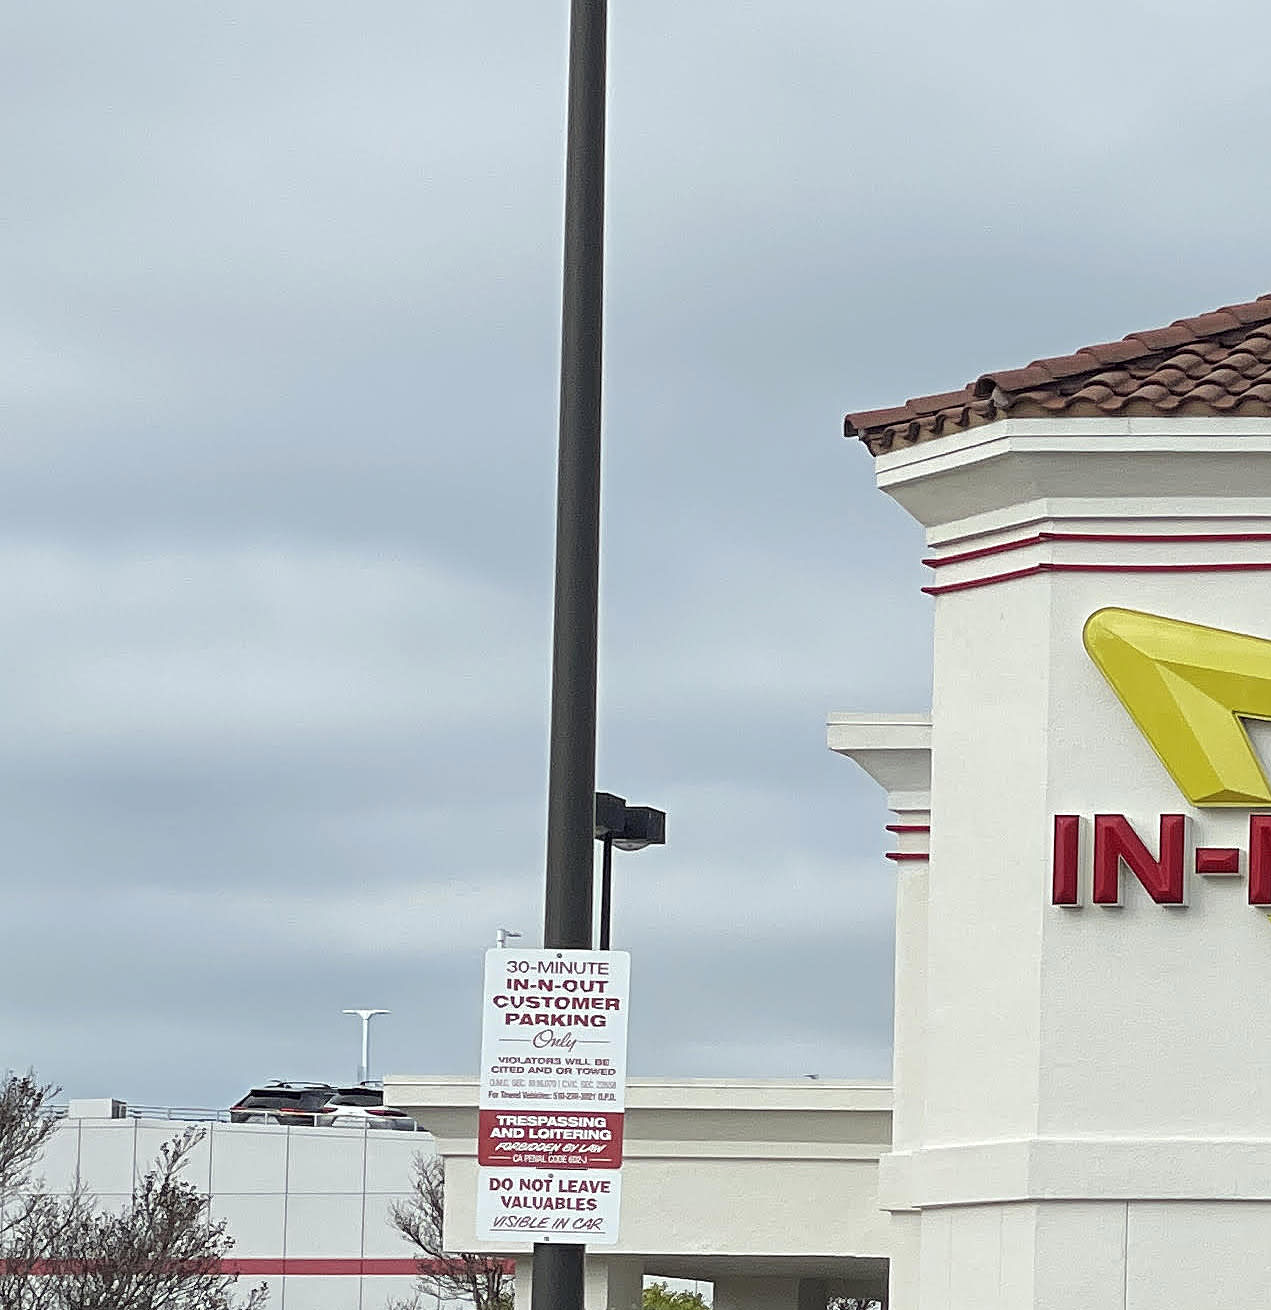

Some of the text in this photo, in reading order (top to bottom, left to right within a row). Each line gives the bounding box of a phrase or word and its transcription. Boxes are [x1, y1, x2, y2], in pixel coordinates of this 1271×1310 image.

[506, 960, 609, 975] 30-MINUTE
[506, 978, 609, 993] IN-N-OUT
[493, 995, 620, 1010] CUSTOMER
[505, 1013, 607, 1027] PARKING
[533, 1029, 577, 1052] Only
[498, 1056, 610, 1066] VIOLATORS WILL BE
[491, 1065, 616, 1076] CITED AND OR TOWED
[488, 1090, 499, 1098] For
[496, 1114, 607, 1128] TRESPASSING
[490, 1127, 612, 1141] AND LOITERING
[495, 1141, 608, 1154] FORBIDDEN BY LAW
[512, 1153, 523, 1162] CA
[489, 1177, 611, 1194] DO NOT LEAVE
[501, 1195, 598, 1211] VALUABLES
[493, 1215, 604, 1231] VISIBLE IN CAR
